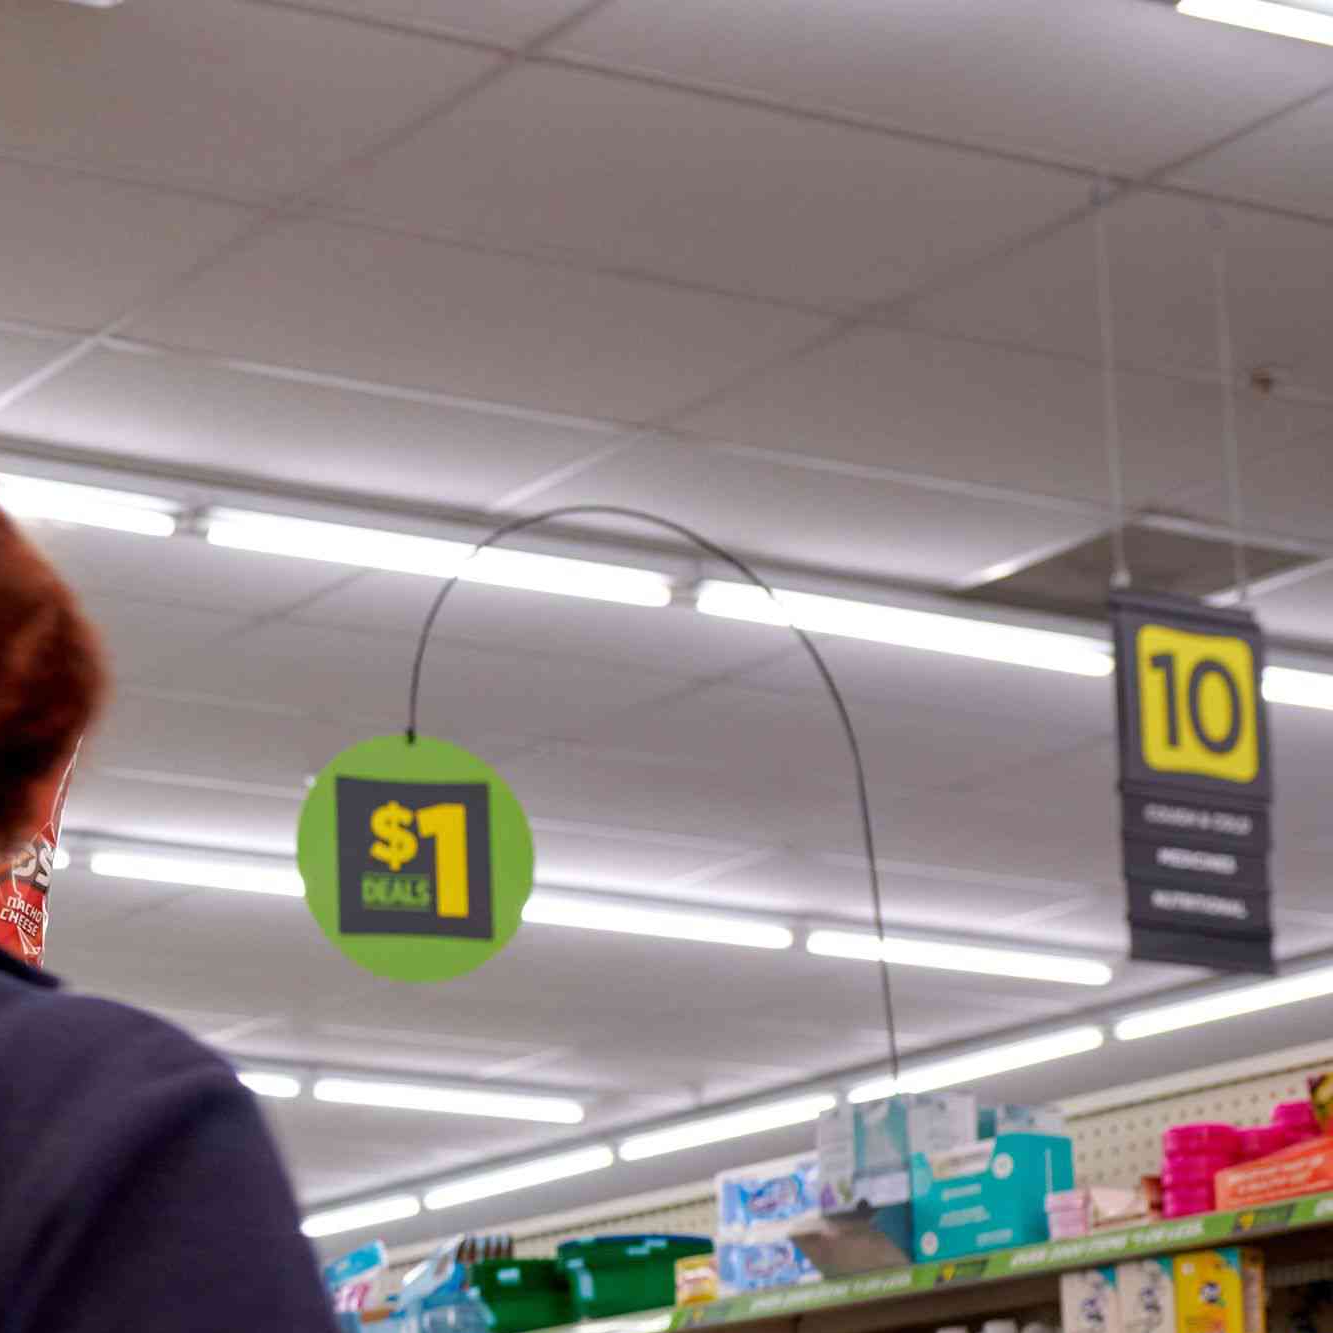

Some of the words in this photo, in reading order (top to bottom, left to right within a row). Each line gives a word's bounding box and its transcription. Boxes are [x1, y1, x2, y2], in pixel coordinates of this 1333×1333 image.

[1149, 651, 1243, 755] 10
[369, 800, 469, 919] $1
[0, 907, 39, 937] CHEESE
